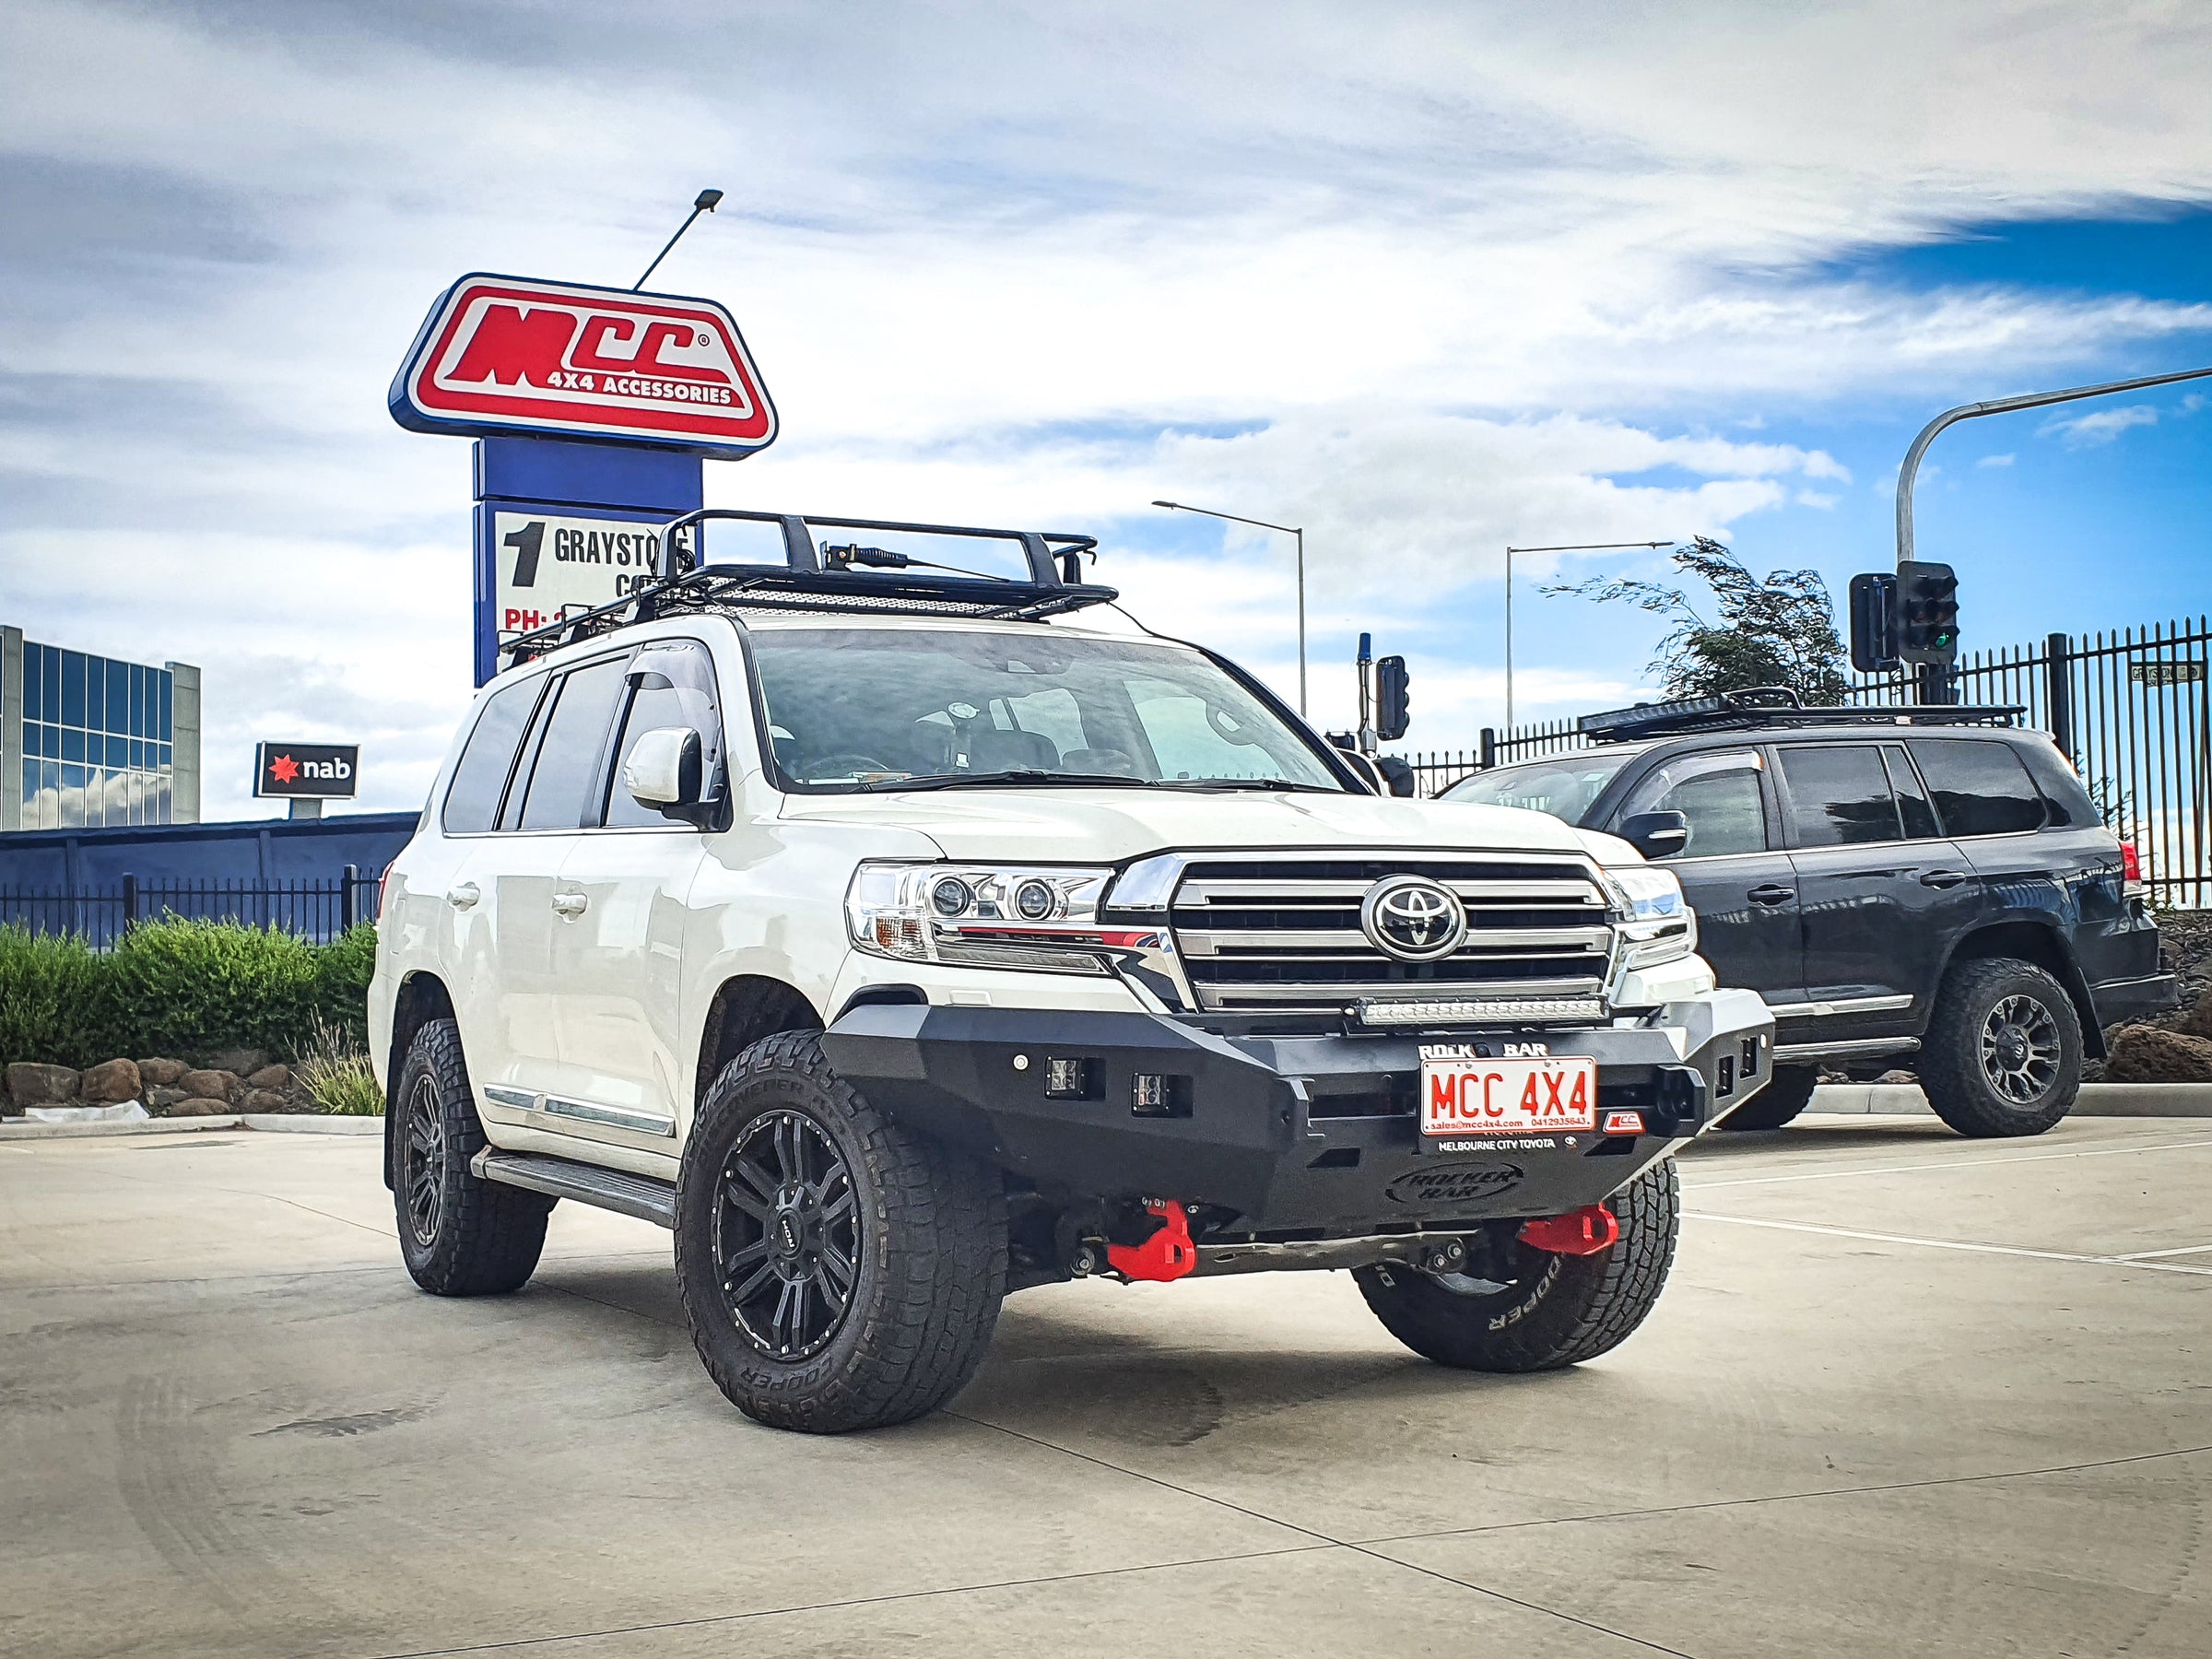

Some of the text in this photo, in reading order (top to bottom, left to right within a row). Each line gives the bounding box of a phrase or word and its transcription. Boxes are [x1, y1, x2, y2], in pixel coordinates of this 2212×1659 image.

[443, 304, 733, 386] MCC
[547, 371, 733, 405] 4X4 ACCESSORIES
[503, 522, 545, 587] 1
[555, 528, 688, 570] GRAYSTOE
[302, 757, 351, 780] nab
[1503, 1042, 1548, 1057] BAR
[1431, 1071, 1586, 1119] MCC 4X4
[1430, 1119, 1524, 1130] sales@mcc4x4.com
[1438, 1138, 1556, 1151] MELBOURNE CITY TOYOTA
[1488, 1252, 1564, 1331] OOPER
